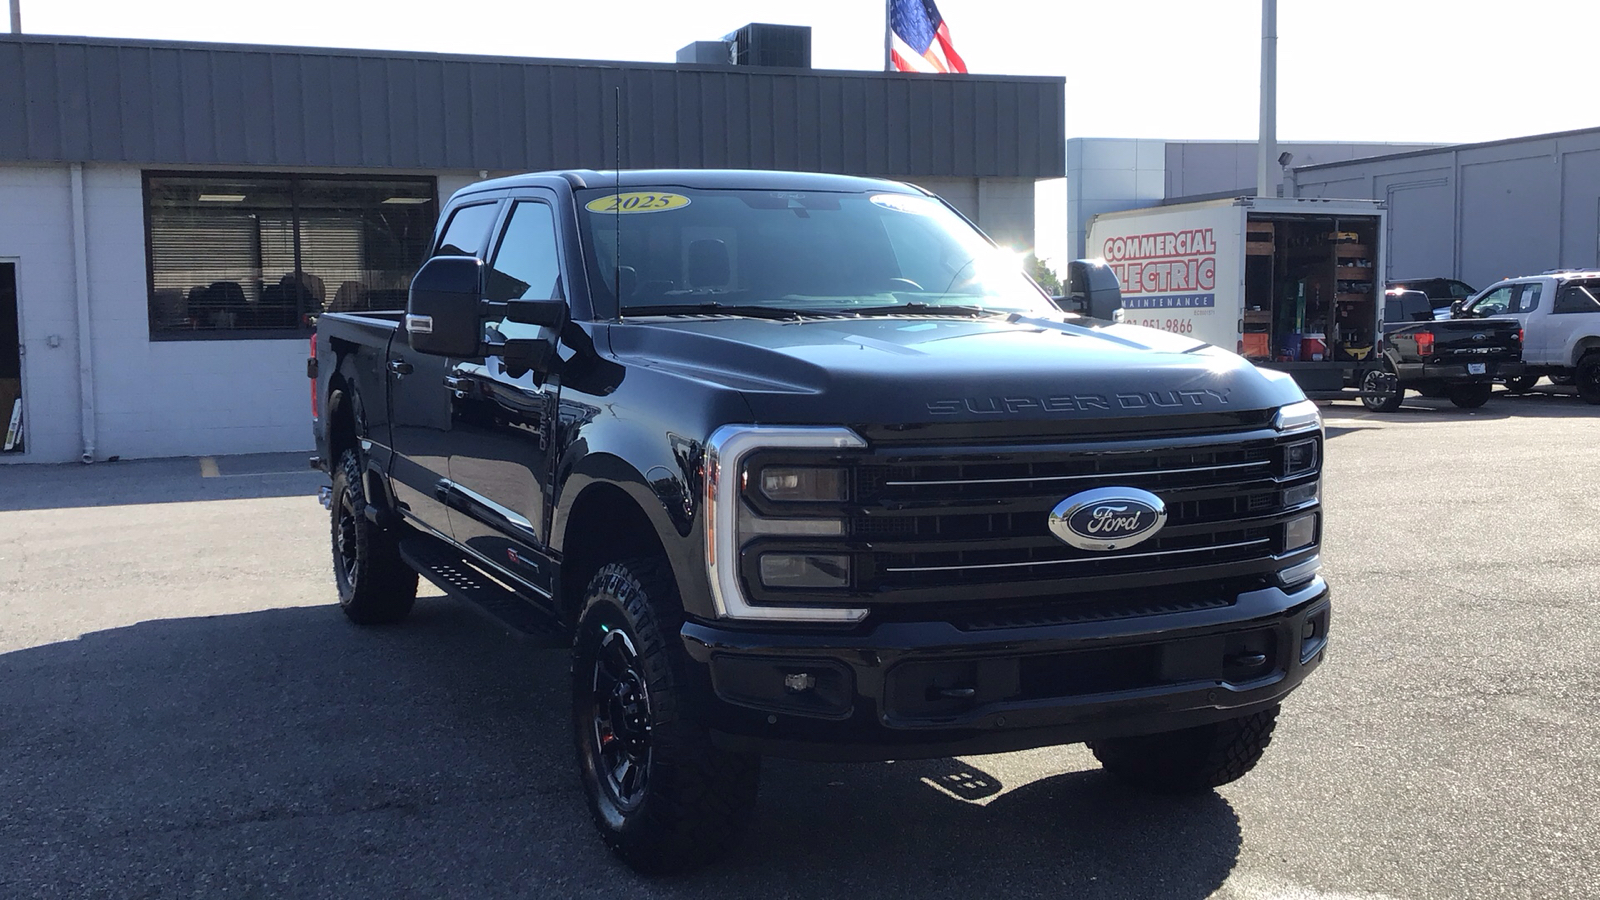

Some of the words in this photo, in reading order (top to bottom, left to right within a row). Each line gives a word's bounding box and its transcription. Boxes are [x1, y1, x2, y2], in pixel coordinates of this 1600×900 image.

[604, 195, 673, 212] 2025
[1103, 228, 1216, 262] COMMERCIAL
[1109, 257, 1215, 293] LECTRIC
[1121, 296, 1208, 307] MAINTENANCE
[926, 393, 1111, 415] SUPER
[1116, 387, 1232, 409] DUTY
[1087, 505, 1141, 533] Ford
